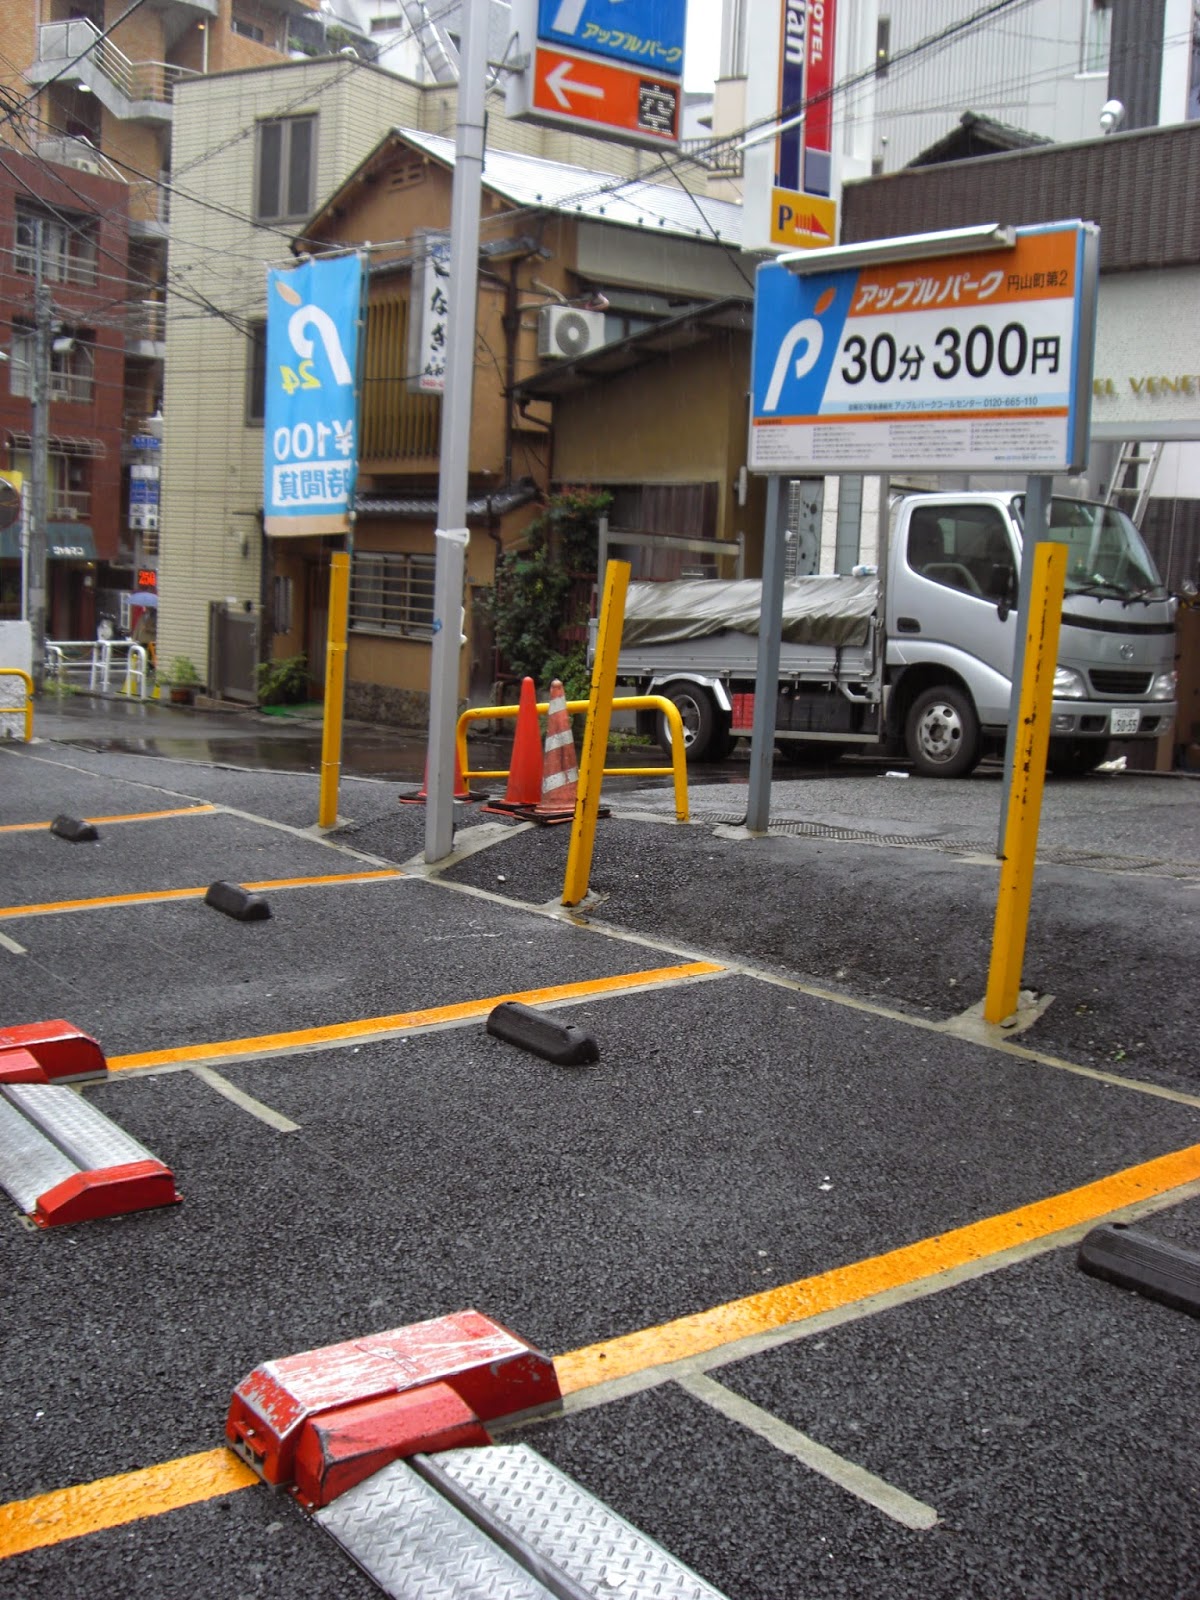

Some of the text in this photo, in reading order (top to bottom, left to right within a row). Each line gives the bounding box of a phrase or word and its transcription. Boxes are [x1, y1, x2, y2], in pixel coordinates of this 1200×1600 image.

[581, 22, 682, 63] アップルパーク
[811, 0, 824, 66] OTEL
[638, 84, 676, 137] 空
[778, 204, 793, 231] P
[855, 269, 1069, 311] アップルパーク 円山町第2
[1128, 374, 1200, 395] VENE
